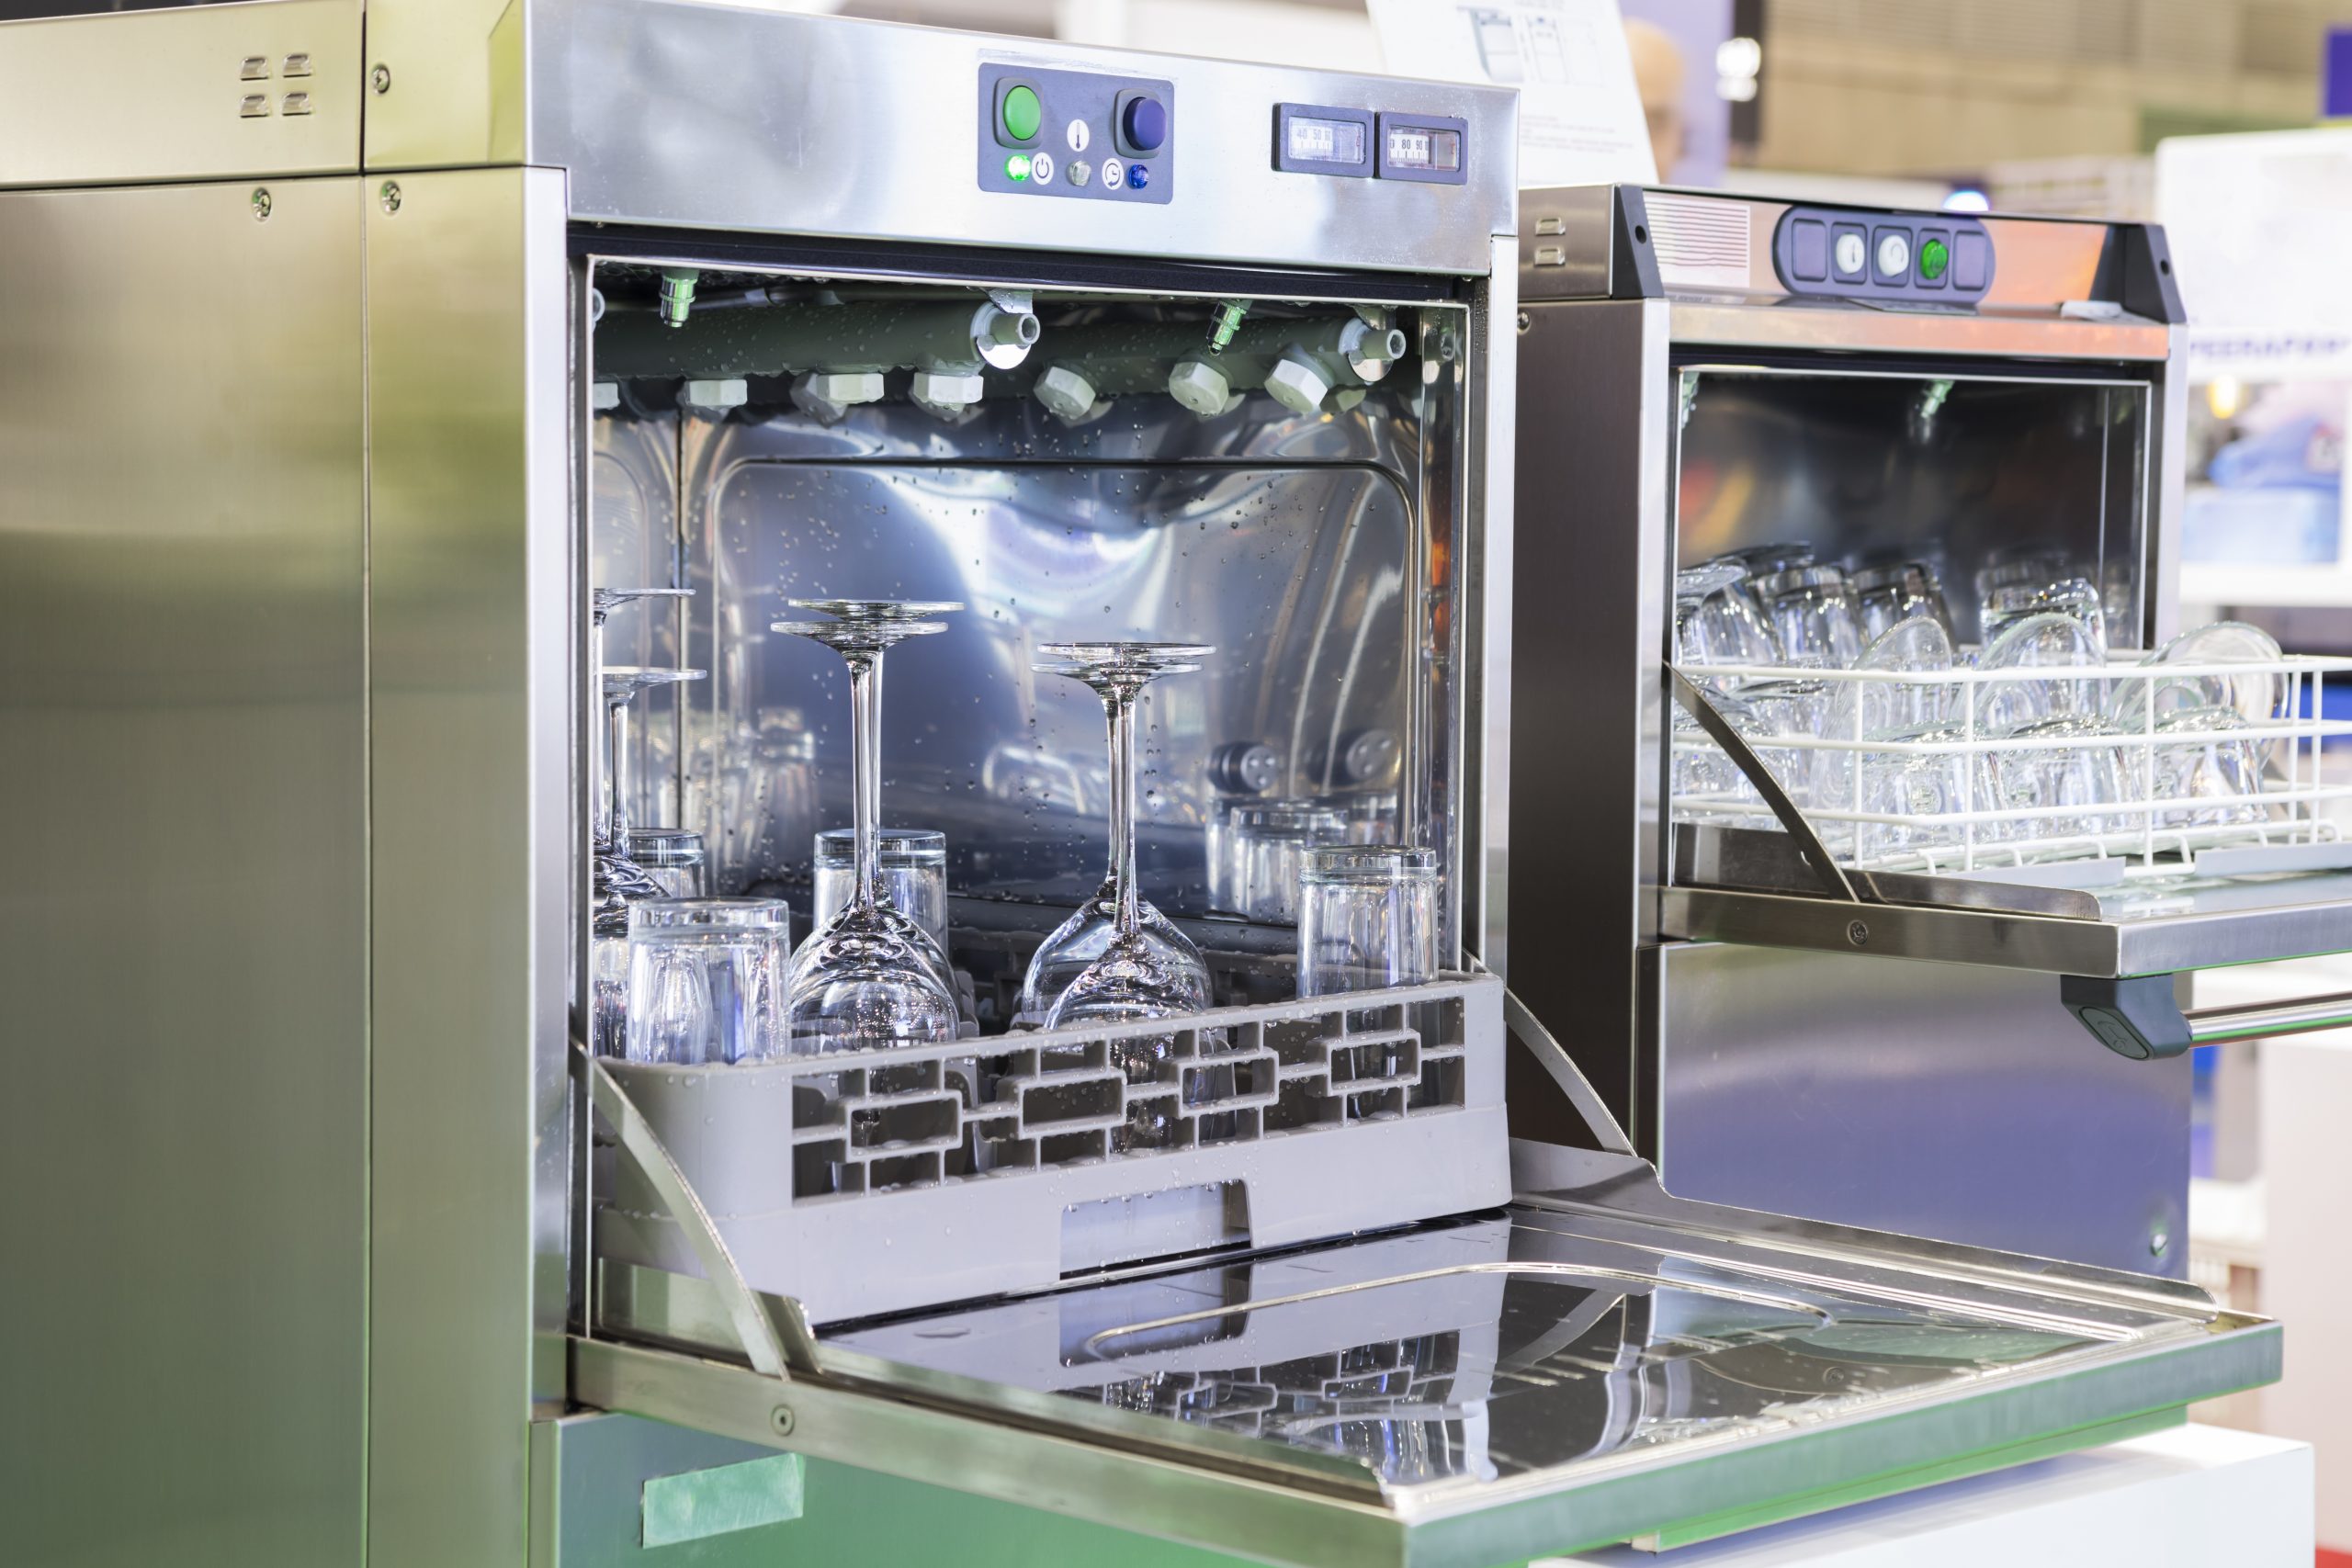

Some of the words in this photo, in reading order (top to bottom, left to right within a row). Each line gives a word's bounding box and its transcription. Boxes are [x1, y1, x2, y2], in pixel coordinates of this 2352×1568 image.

[1297, 129, 1307, 139] 40
[1313, 129, 1321, 140] 50
[1401, 139, 1411, 150] 80
[1416, 140, 1423, 151] 90
